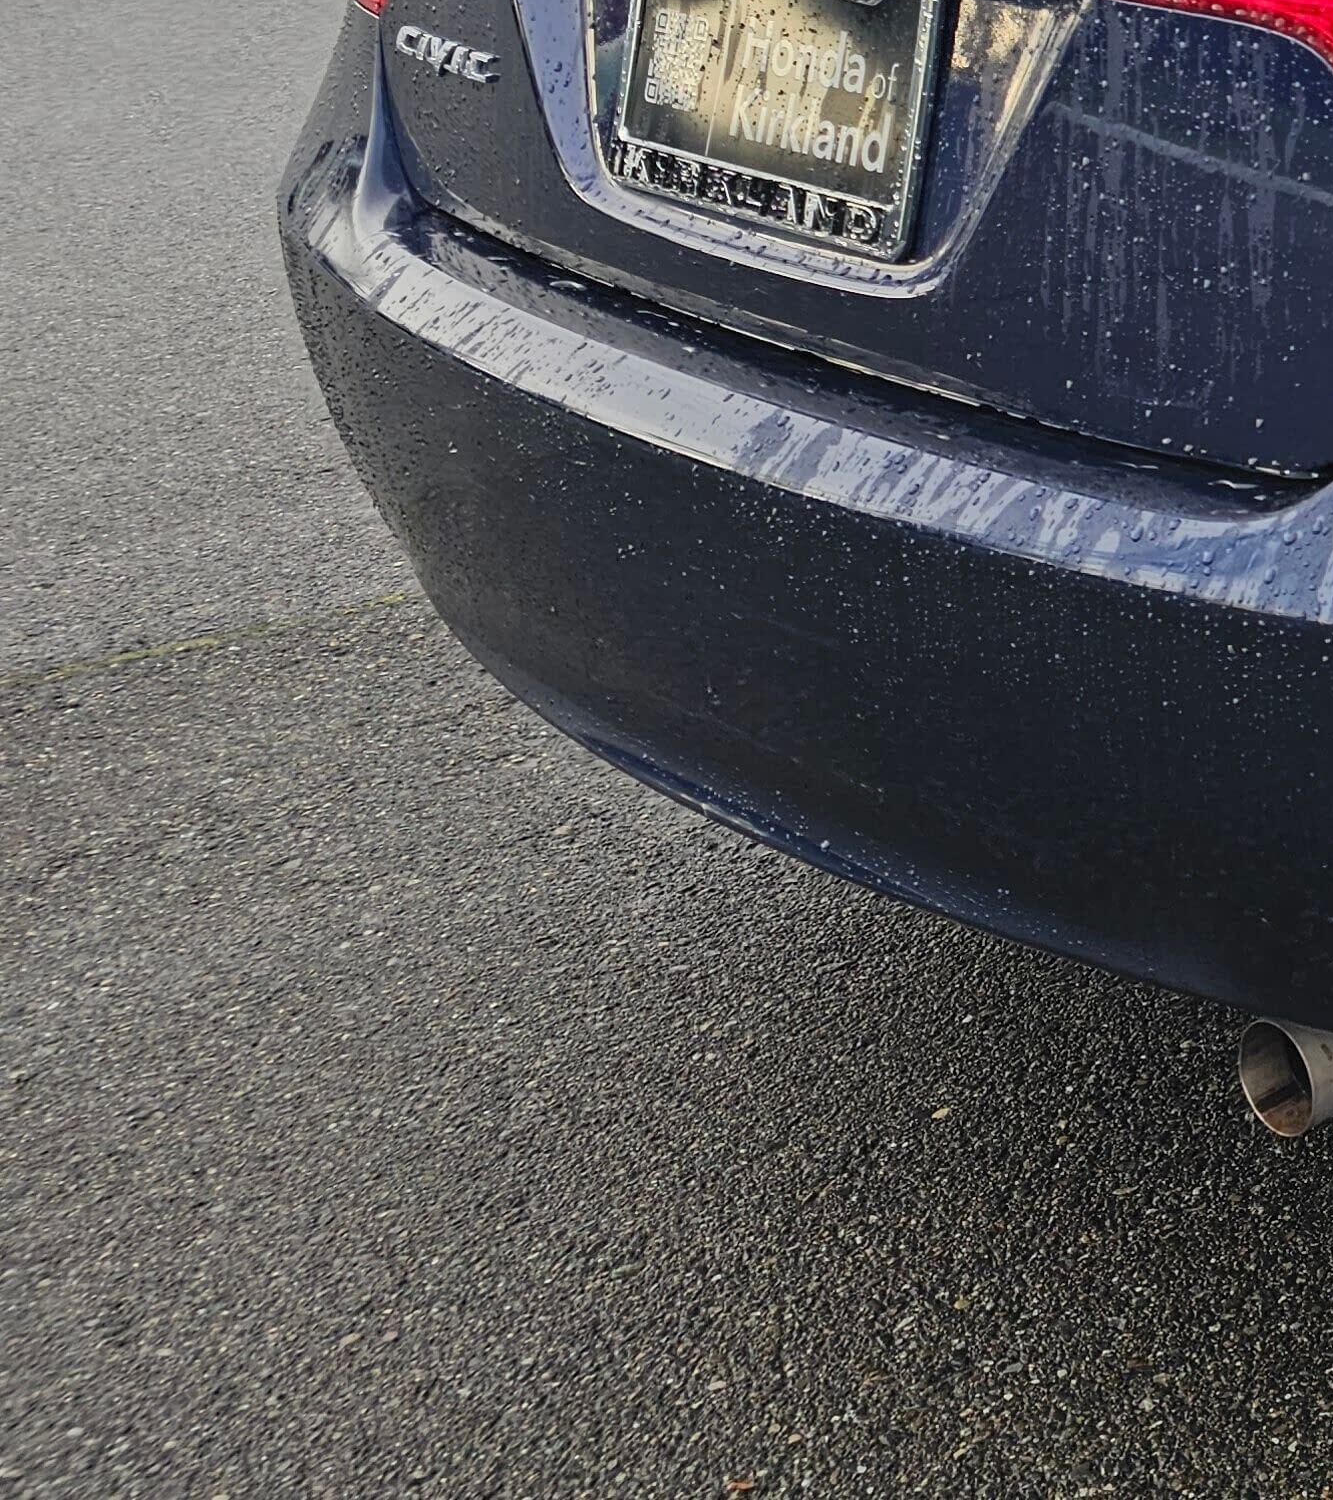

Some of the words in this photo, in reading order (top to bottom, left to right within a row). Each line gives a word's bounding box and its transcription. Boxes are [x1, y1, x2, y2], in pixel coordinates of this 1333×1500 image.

[396, 25, 501, 84] CIVIC
[740, 15, 866, 94] Honda
[870, 62, 901, 102] of
[729, 84, 894, 174] Kirkland
